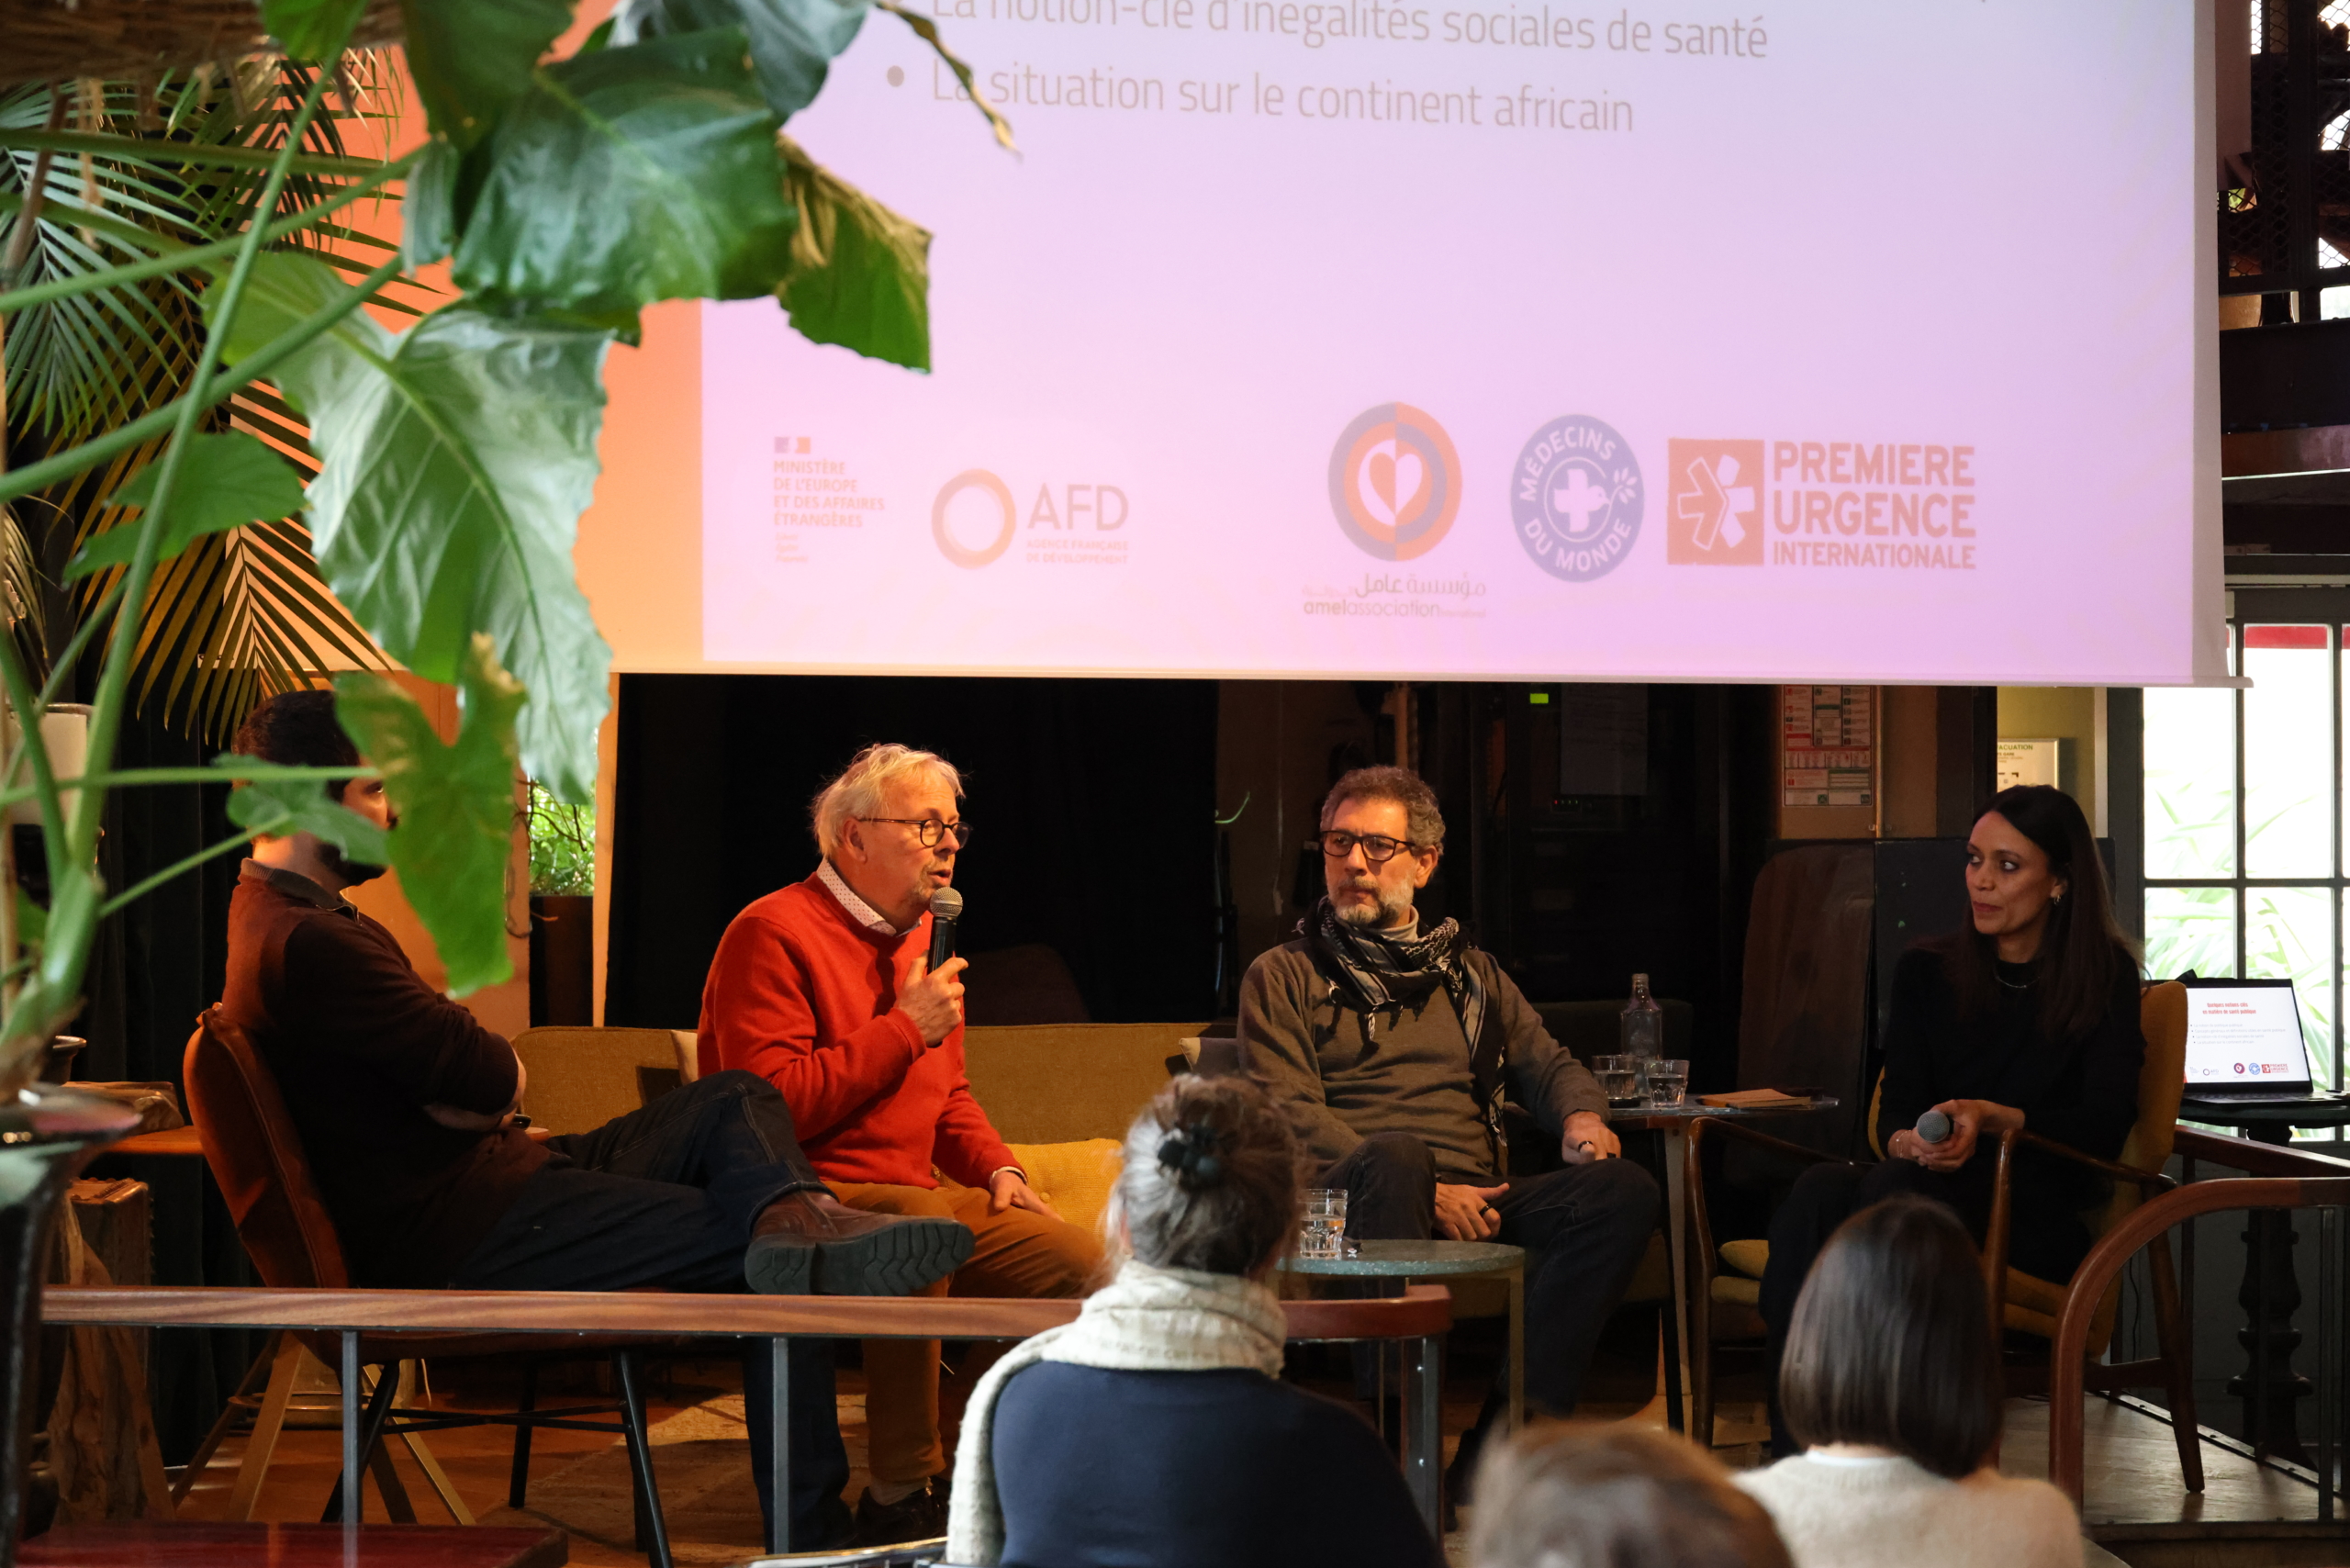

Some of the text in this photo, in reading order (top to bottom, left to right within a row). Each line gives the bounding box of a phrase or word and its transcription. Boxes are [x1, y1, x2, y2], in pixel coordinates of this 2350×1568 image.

[1443, 4, 1595, 50] sociales
[1607, 8, 1652, 53] de
[1664, 16, 1768, 58] santé
[934, 58, 1633, 132] La situation sur le continent africain
[773, 458, 845, 475] MINISTÈRE
[773, 477, 857, 493] DE L'EUROPE
[1519, 426, 1617, 502] MÉDECINS
[1773, 441, 1976, 487] PREMIERE
[773, 495, 885, 510] ET DES AFFAIRES
[773, 510, 863, 528] ÉTRANGÈRES
[1026, 482, 1130, 532] AFD
[1773, 490, 1976, 539] URGENCE
[1524, 518, 1632, 573] DU MONDE
[1773, 541, 1976, 569] INTERNATIONALE
